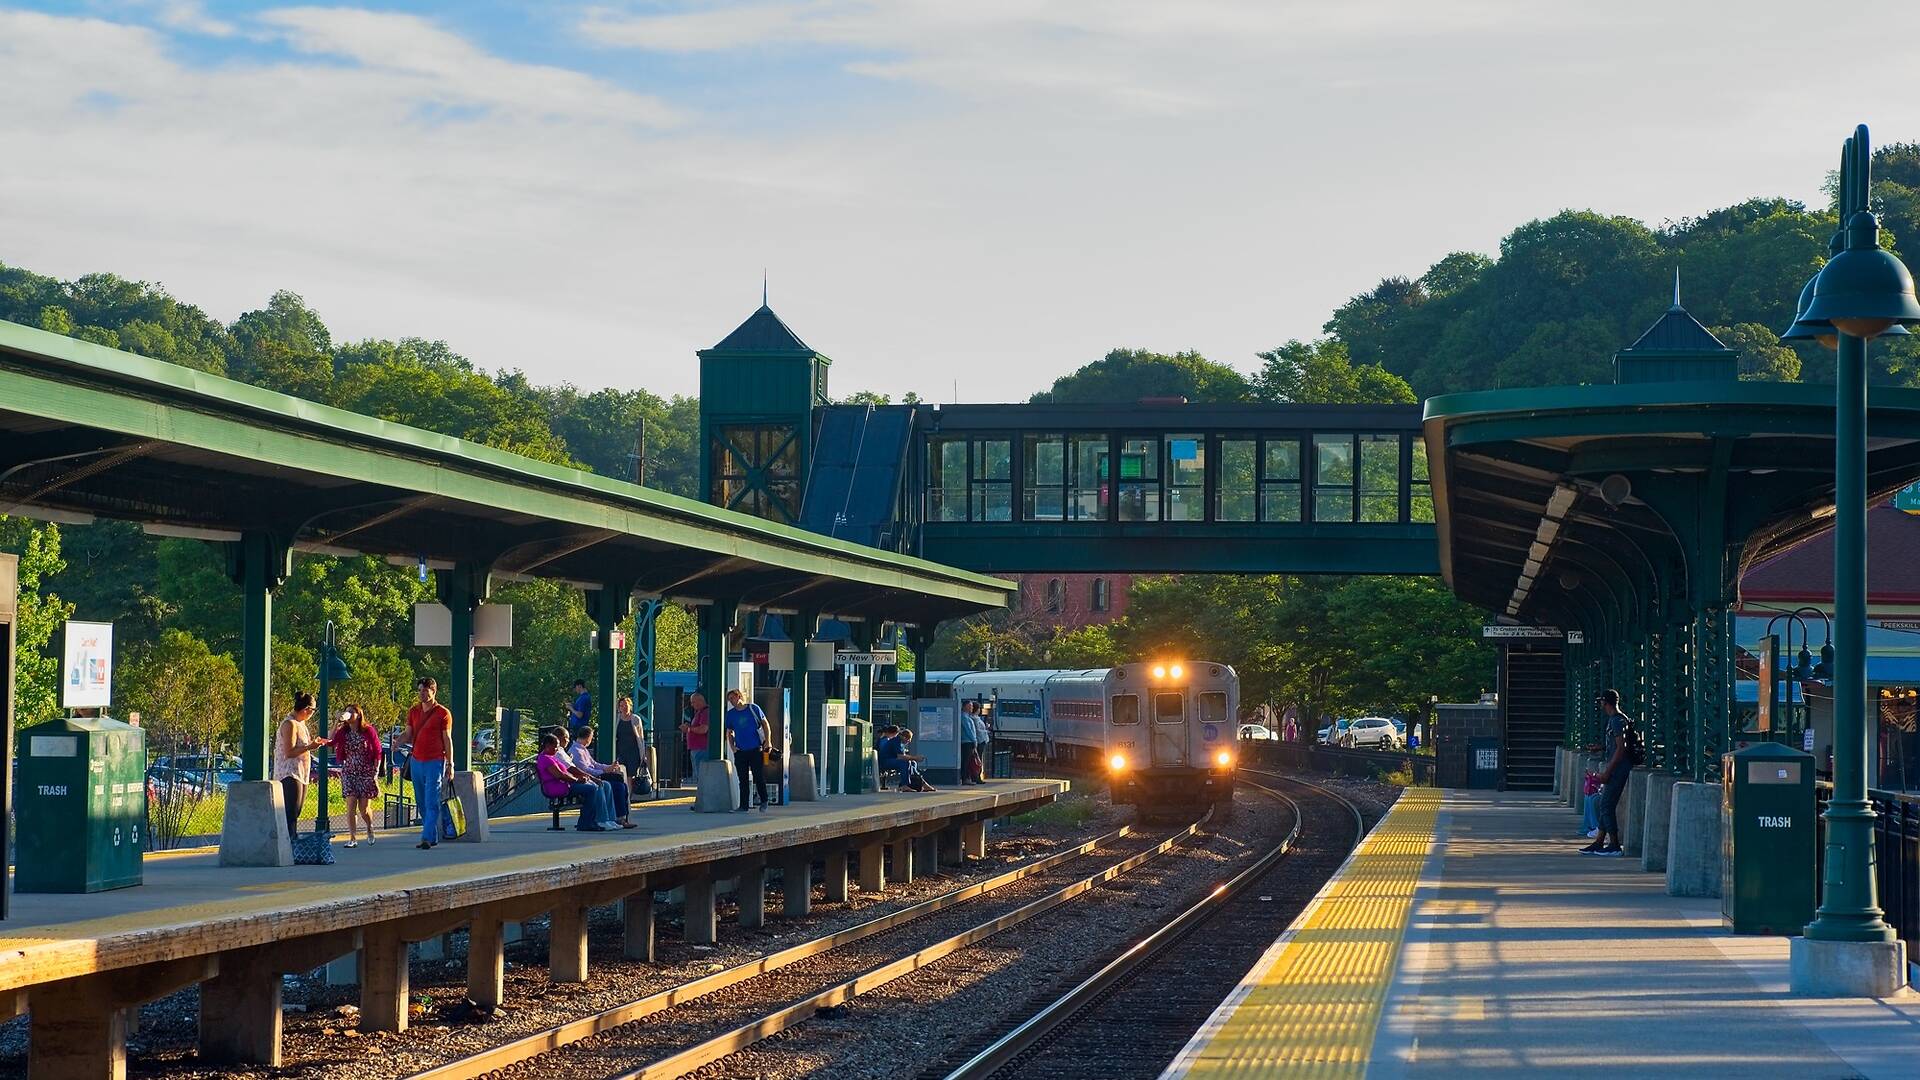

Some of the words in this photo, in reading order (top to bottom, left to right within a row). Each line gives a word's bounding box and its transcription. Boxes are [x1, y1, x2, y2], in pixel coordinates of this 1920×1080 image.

[1411, 737, 1416, 746] 2
[38, 785, 67, 796] TRASH
[1758, 816, 1791, 828] TRASH
